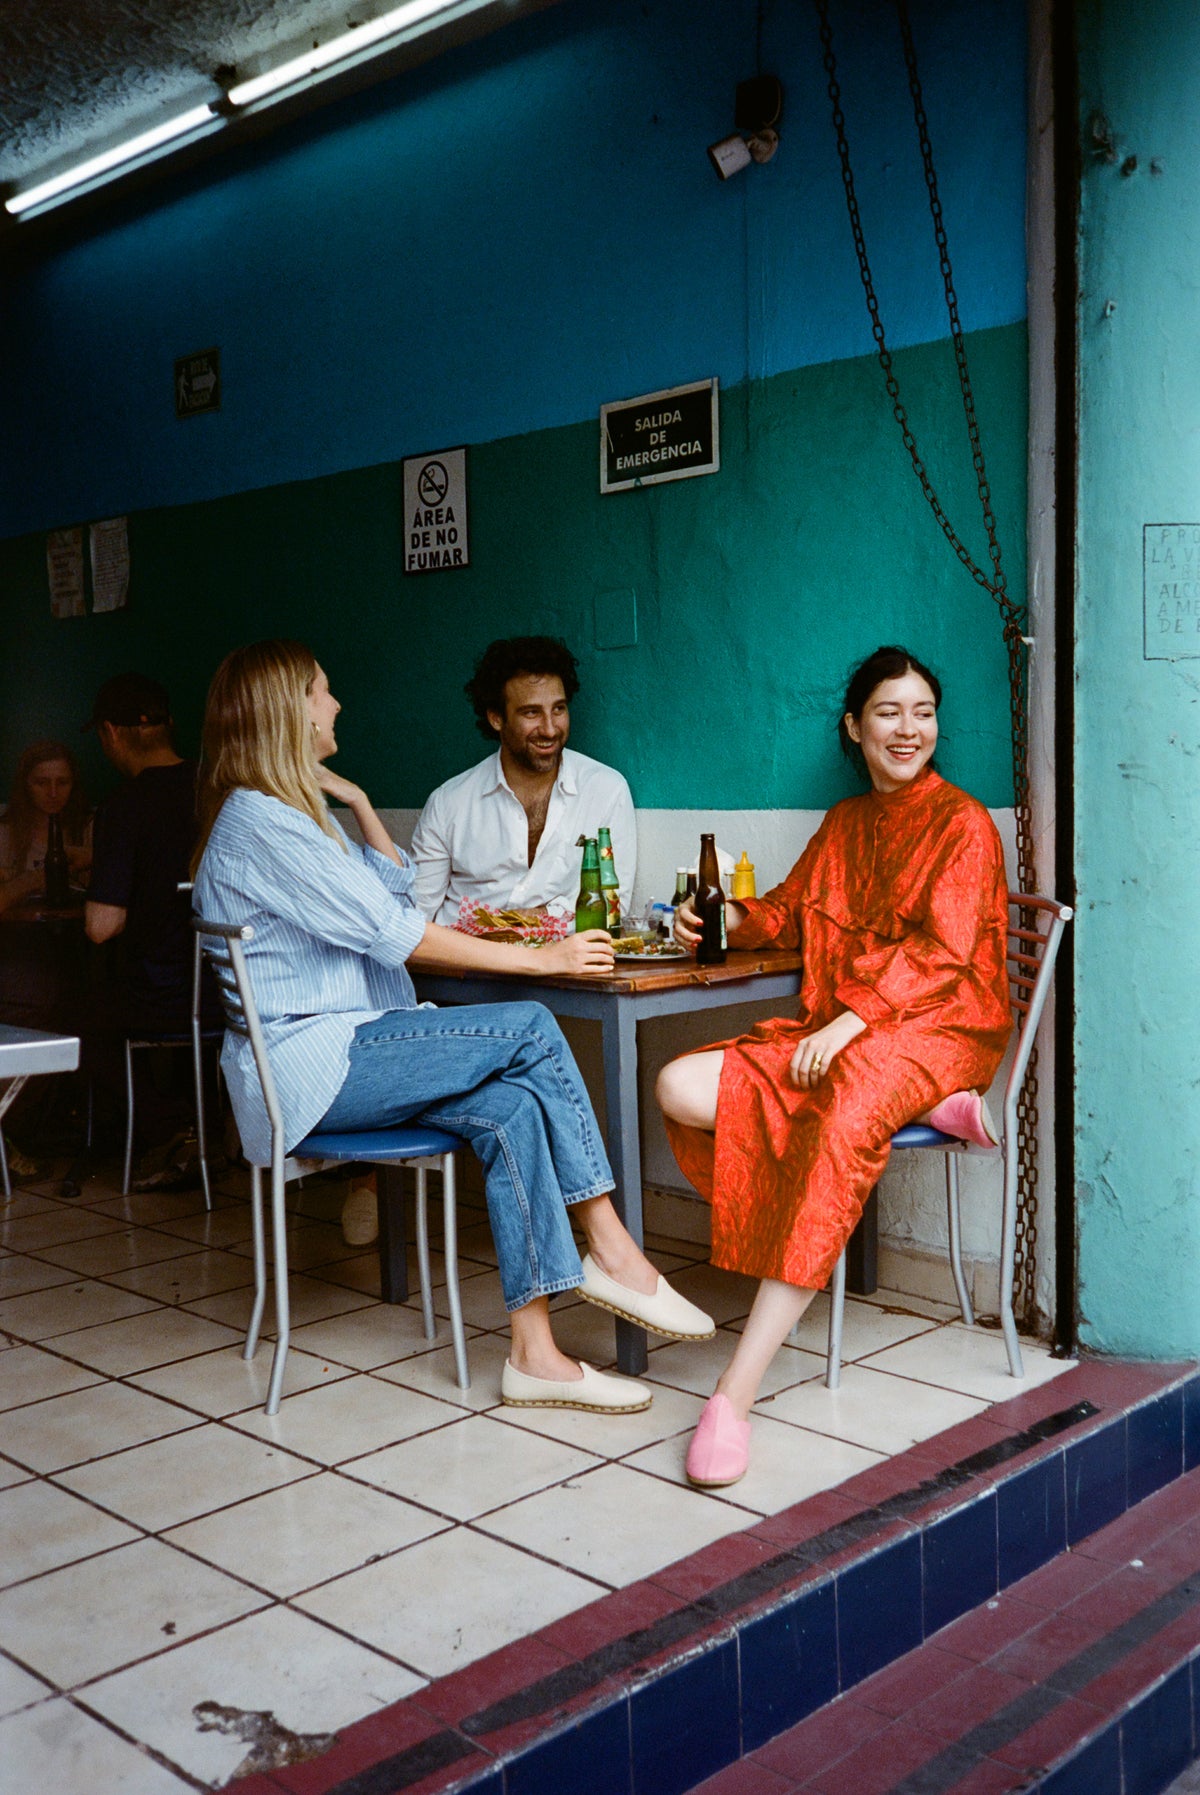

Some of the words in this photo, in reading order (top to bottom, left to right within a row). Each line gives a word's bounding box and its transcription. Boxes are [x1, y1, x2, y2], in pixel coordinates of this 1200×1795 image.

[635, 409, 682, 432] SALIDA
[649, 430, 667, 446] DE
[616, 440, 702, 471] EMERGENCIA
[413, 506, 455, 529] ÁREA
[411, 530, 431, 549] DE
[436, 527, 458, 546] NO
[407, 547, 463, 570] FUMAR
[1152, 547, 1174, 563] LA
[1157, 601, 1169, 617] A
[1159, 618, 1184, 633] DE
